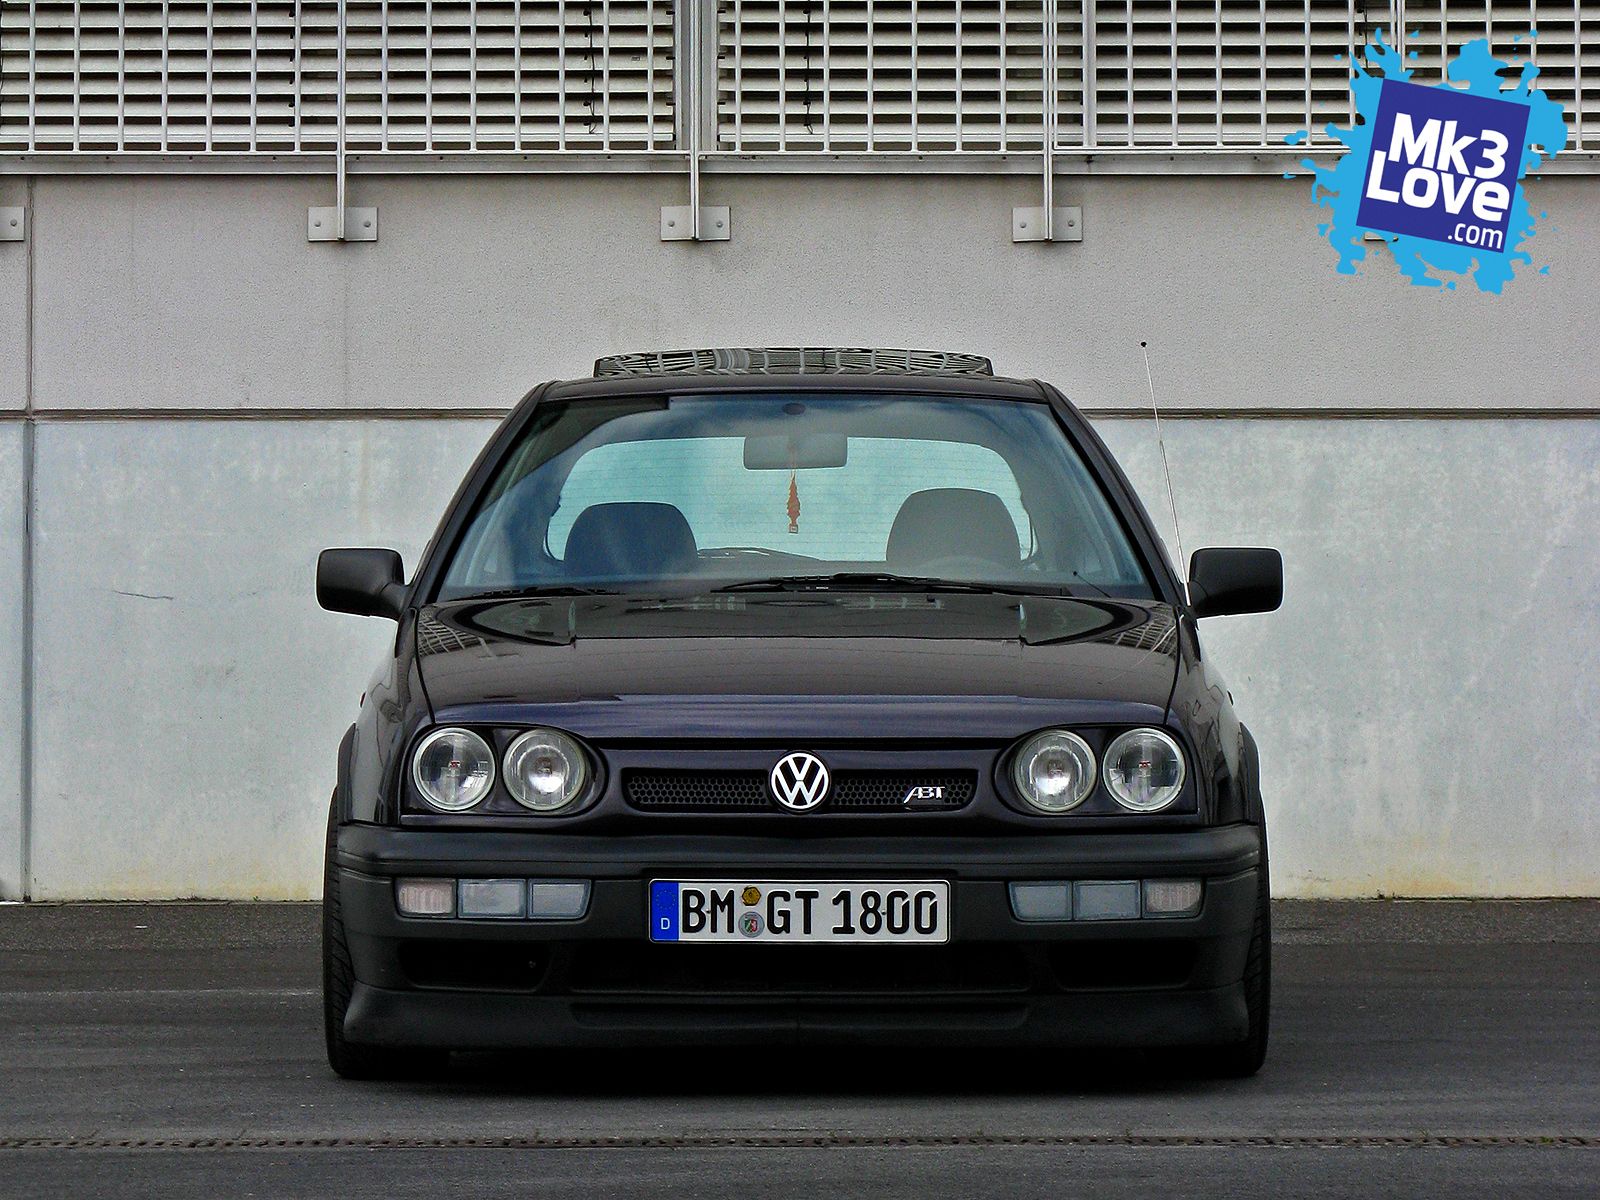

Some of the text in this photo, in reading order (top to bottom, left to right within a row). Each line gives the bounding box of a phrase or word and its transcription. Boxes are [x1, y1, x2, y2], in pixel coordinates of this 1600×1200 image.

[903, 786, 946, 804] ABT
[681, 889, 938, 935] BM GT 1800
[660, 917, 671, 930] D
